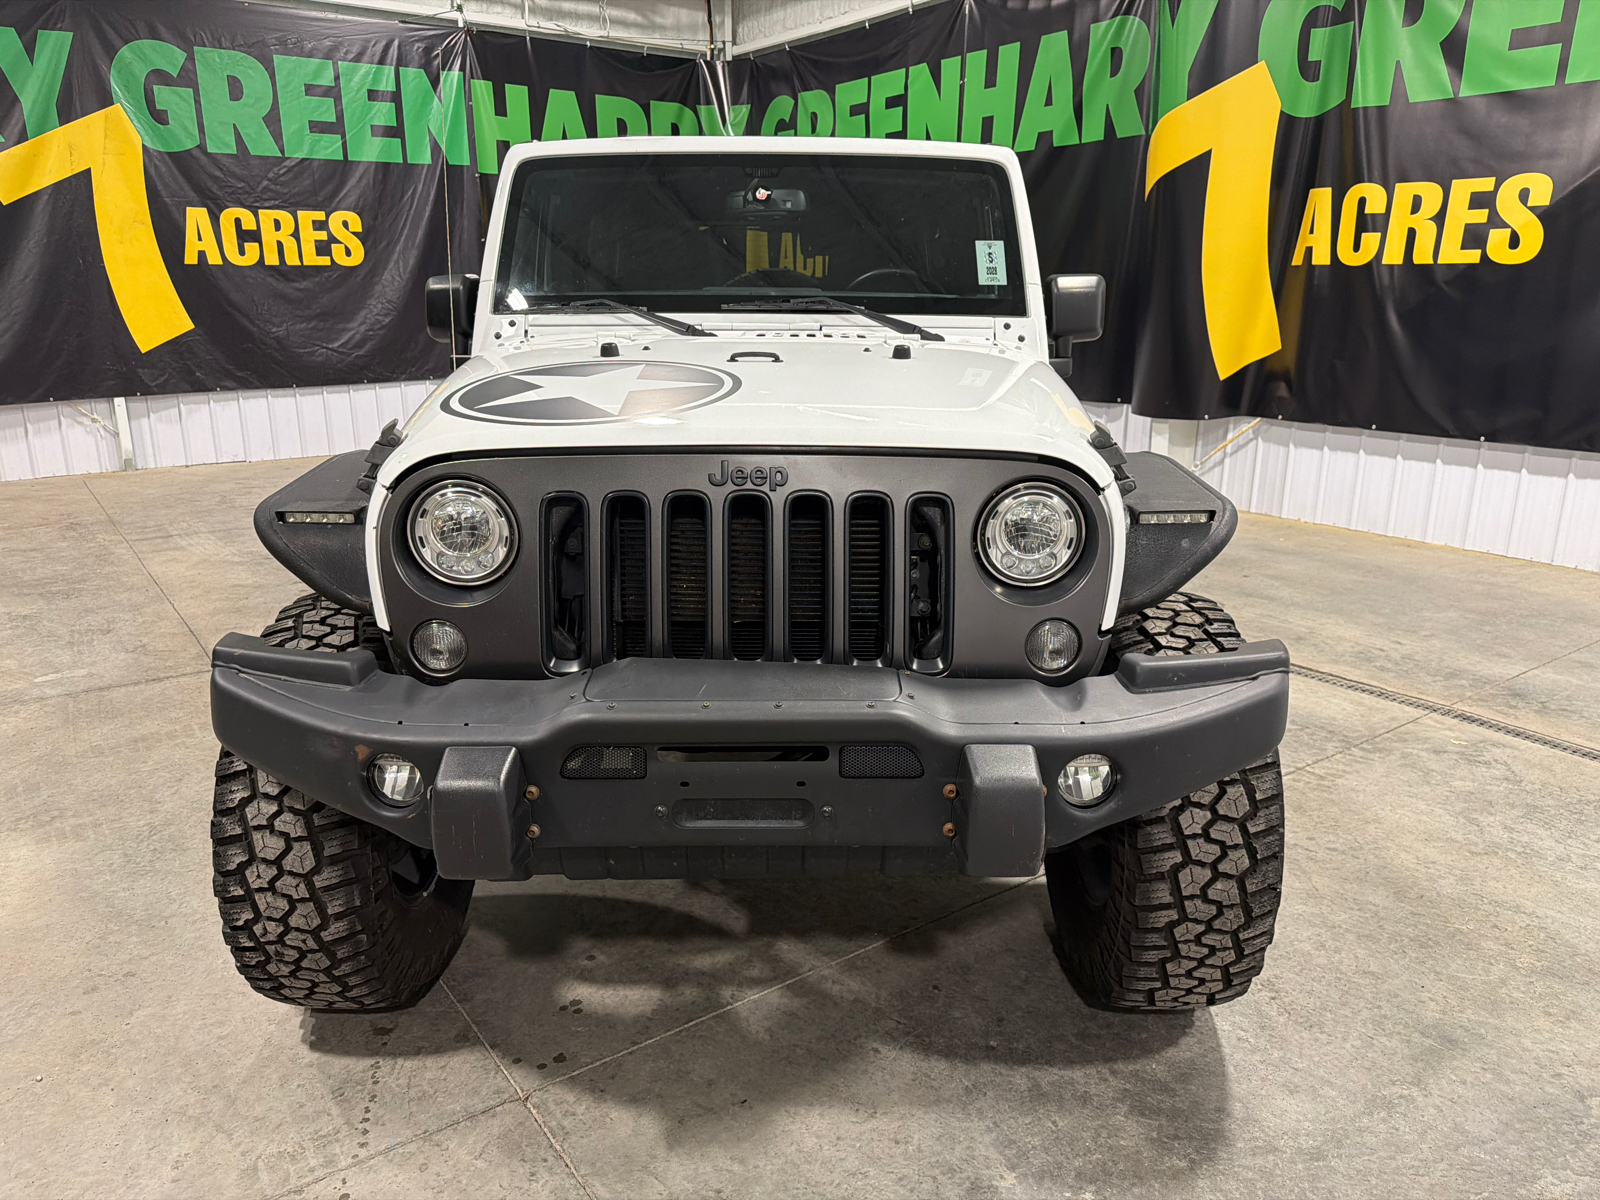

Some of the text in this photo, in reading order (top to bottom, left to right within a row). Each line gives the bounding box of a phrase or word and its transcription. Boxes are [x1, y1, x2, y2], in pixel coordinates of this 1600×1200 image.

[0, 26, 470, 166] Y GREEN
[1257, 0, 1600, 118] GRE
[0, 103, 195, 354] 7
[184, 206, 365, 267] ACRES
[1145, 60, 1282, 381] 7
[1291, 172, 1553, 267] ACRES
[708, 459, 789, 492] Jeep
